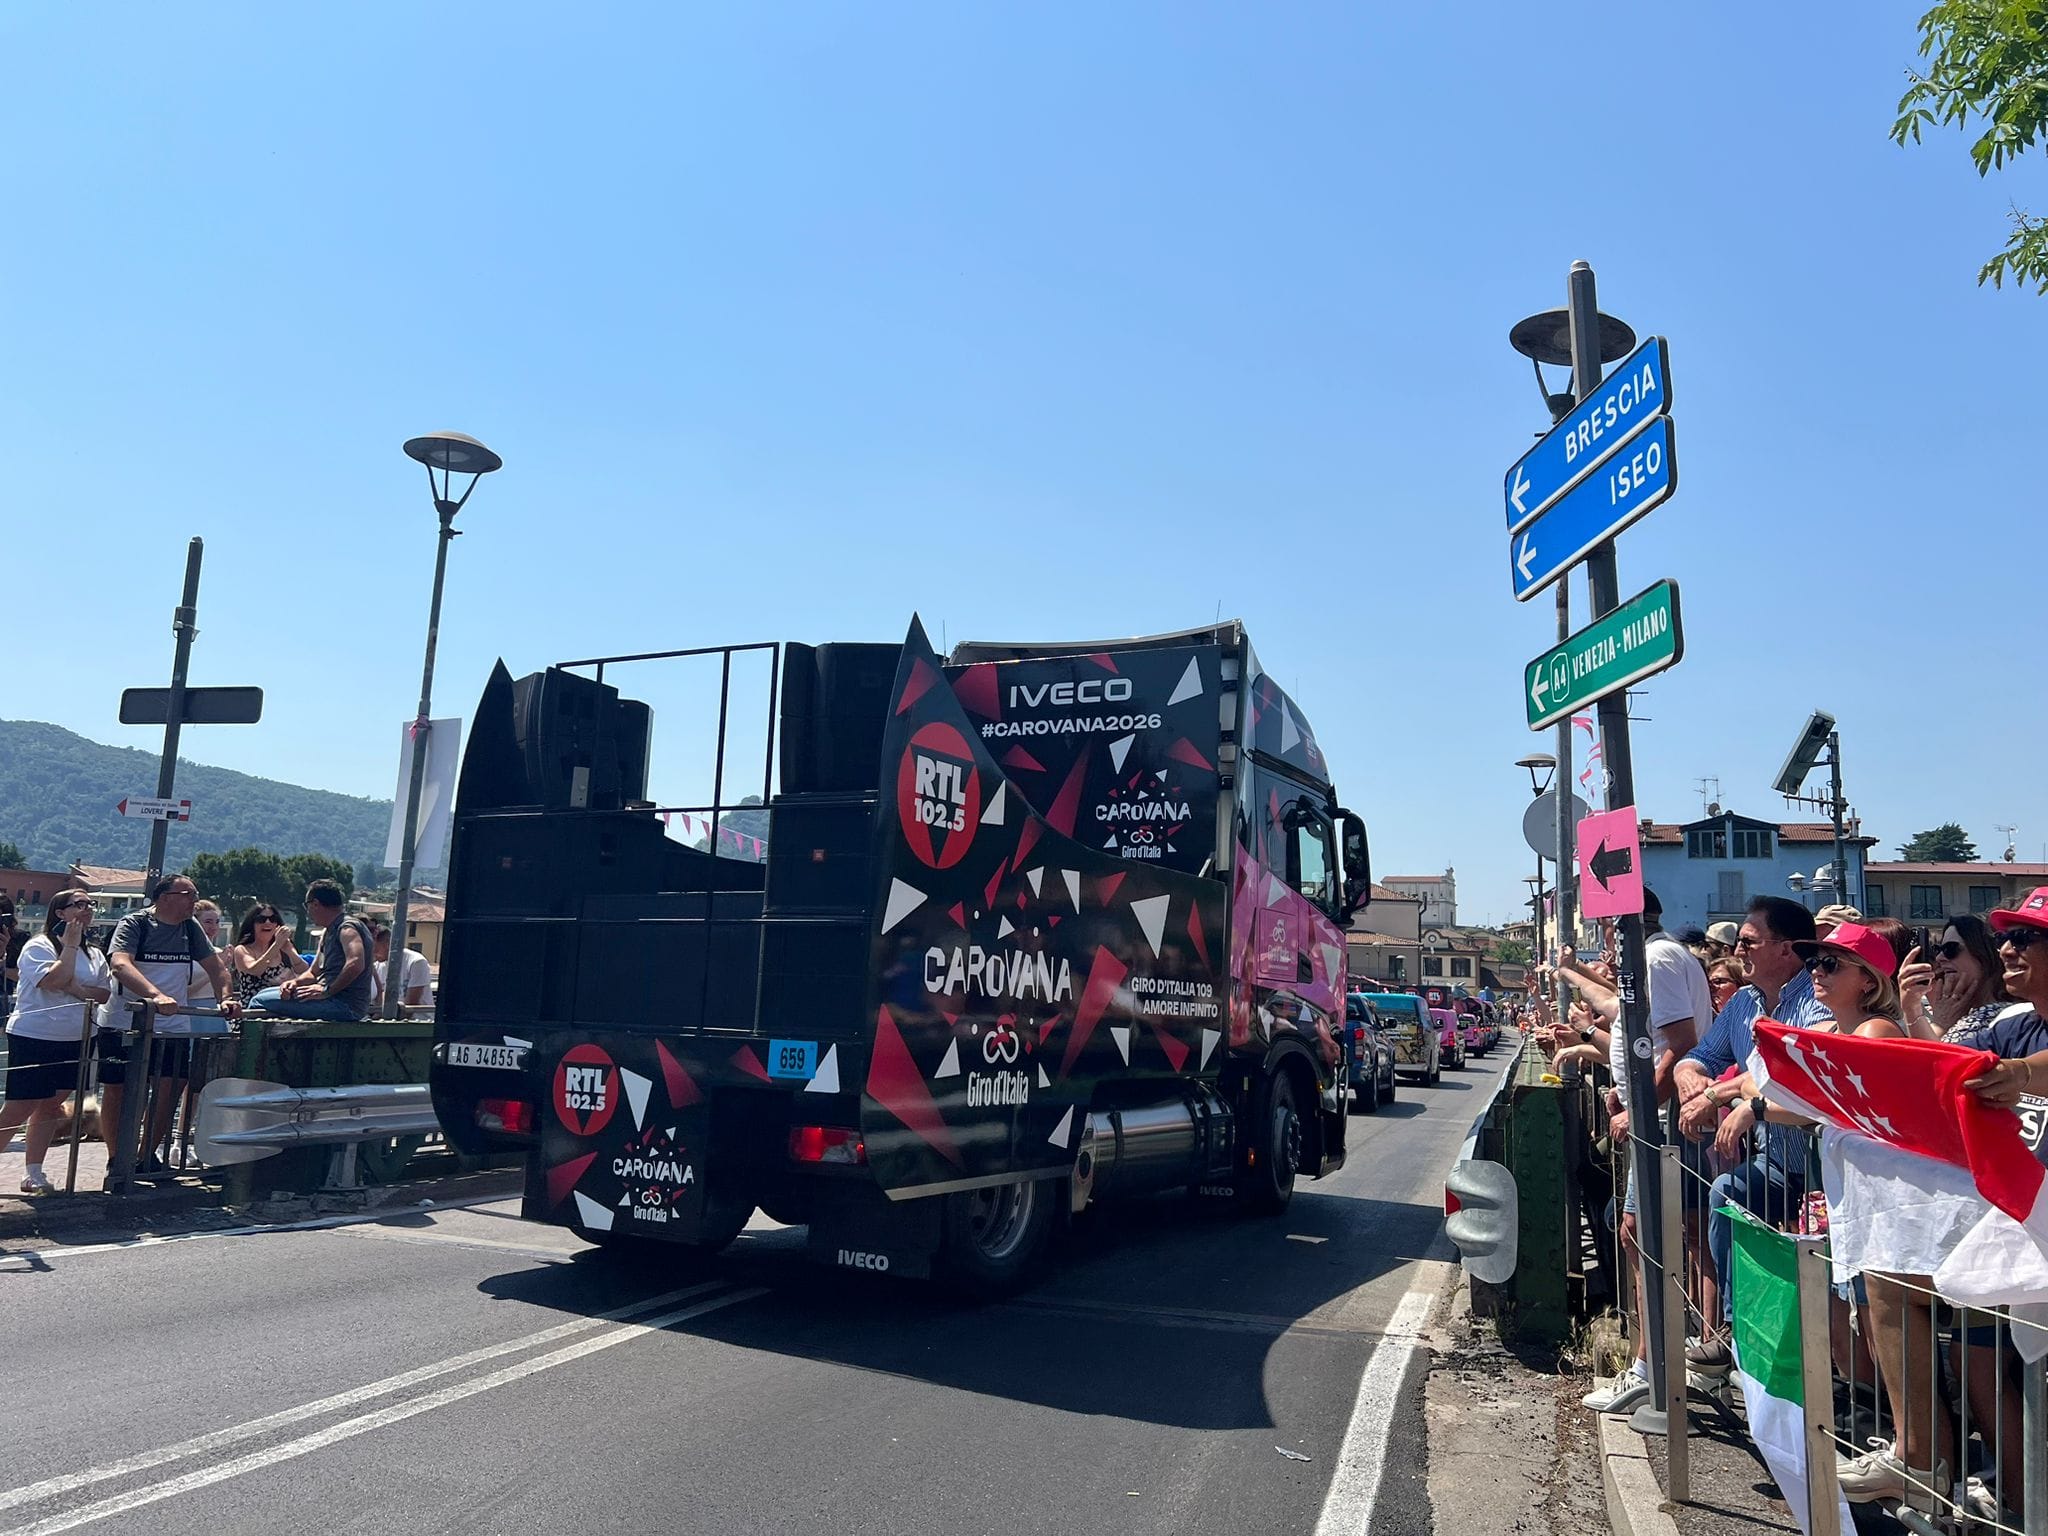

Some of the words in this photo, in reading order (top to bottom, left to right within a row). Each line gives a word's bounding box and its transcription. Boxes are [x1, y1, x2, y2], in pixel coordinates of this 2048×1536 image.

[1566, 363, 1657, 464] BRESCIA
[1611, 441, 1662, 505] ISEO
[1554, 663, 1567, 692] A4
[1009, 678, 1133, 708] IVECO
[982, 714, 1162, 738] #CAROVANA2026
[915, 755, 966, 805] RTL
[914, 798, 966, 833] 102.5
[1095, 801, 1192, 821] CAROVANA
[1122, 845, 1136, 858] Giro
[1137, 845, 1161, 858] d'Italia
[924, 945, 1073, 1003] CAROVANA
[1131, 976, 1156, 994] GIRO
[1157, 979, 1196, 997] D'ITALIA
[1196, 983, 1213, 998] 109
[1143, 999, 1179, 1015] AMORE
[1180, 1001, 1218, 1018] INFINITO
[476, 1048, 514, 1067] 34855
[780, 1047, 805, 1070] 659
[565, 1066, 607, 1094] RTL
[967, 1071, 992, 1108] Giro
[993, 1071, 1029, 1106] d'Italia
[565, 1092, 606, 1112] 102.5
[612, 1158, 695, 1184] CAROVANA
[1199, 1185, 1235, 1196] IVECO
[633, 1205, 647, 1220] Giro
[647, 1206, 667, 1223] d'Italia
[837, 1249, 889, 1271] IVECO
